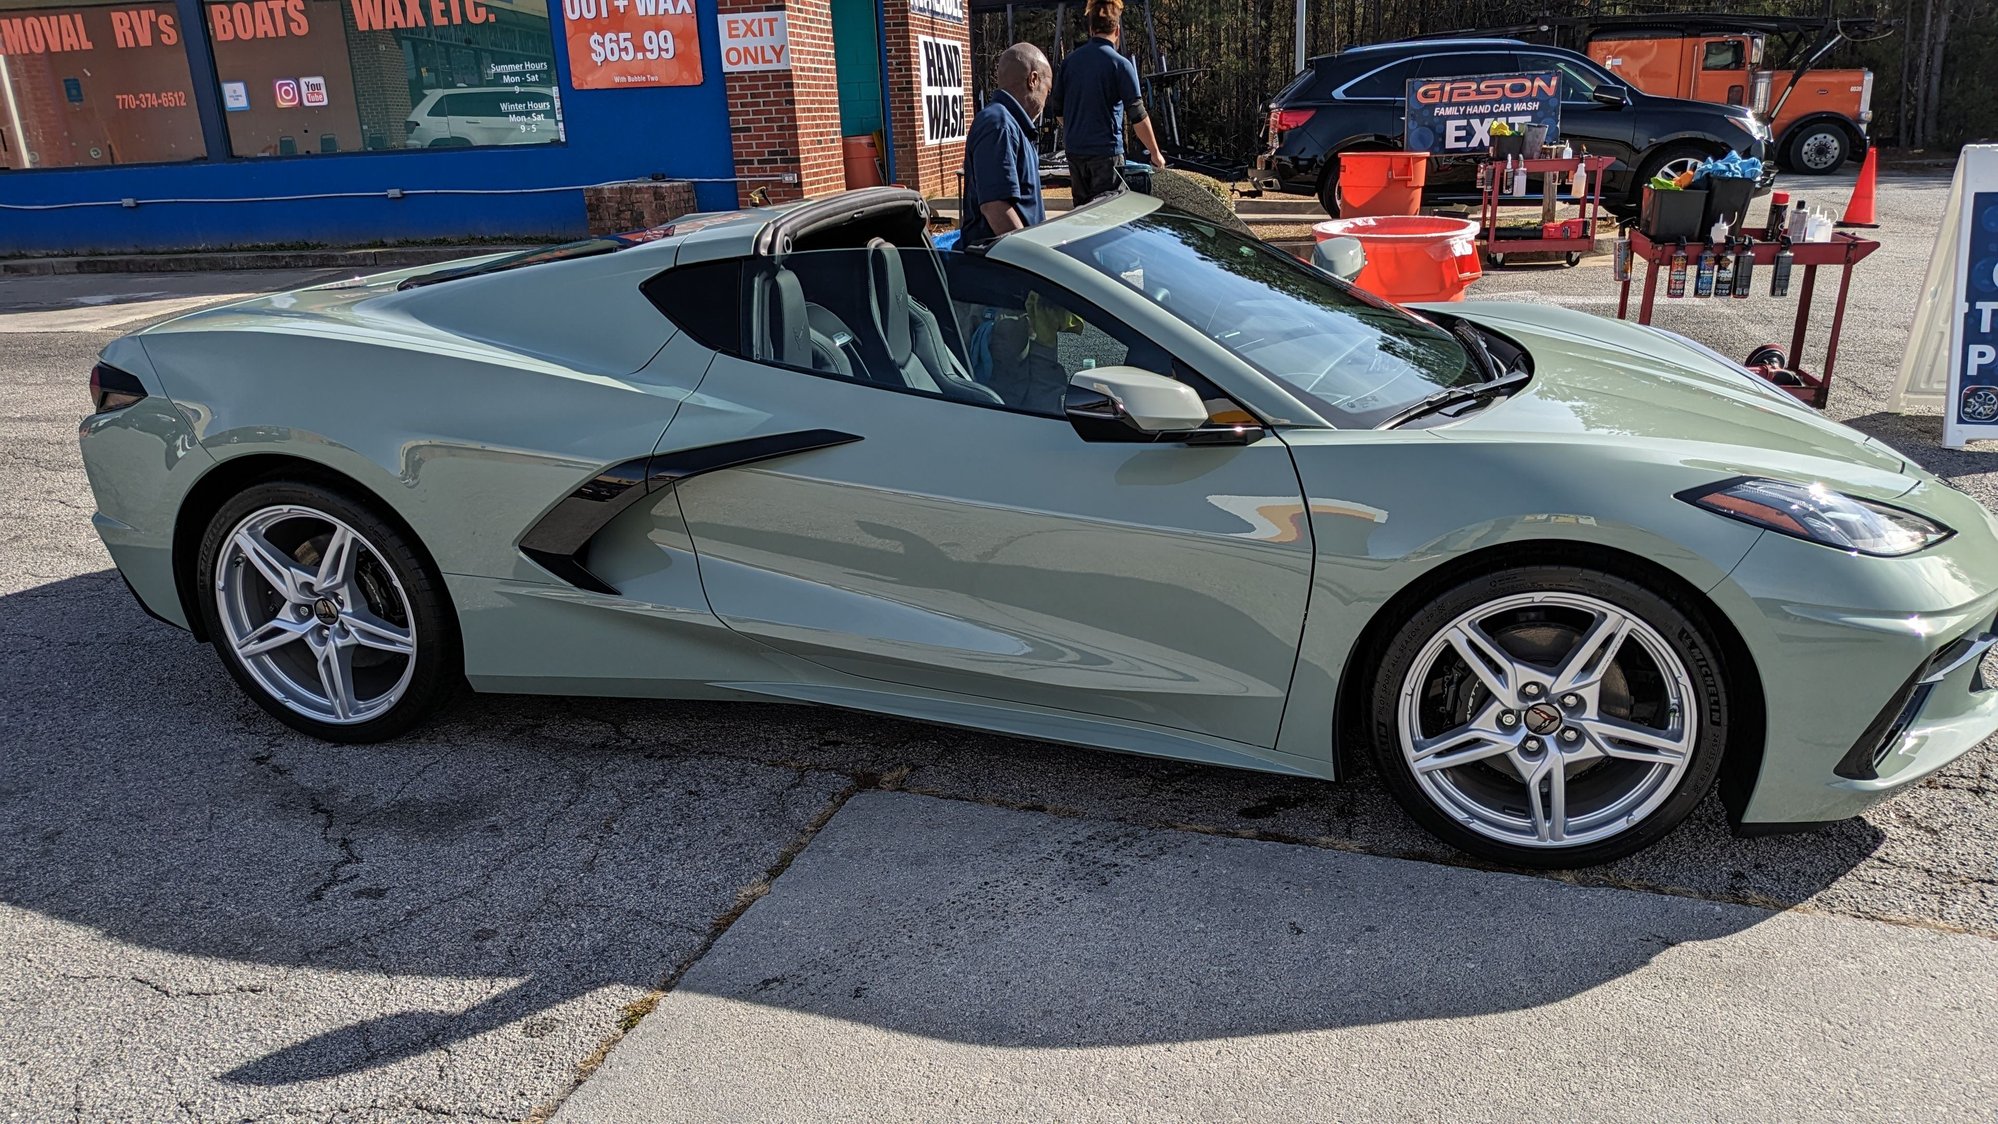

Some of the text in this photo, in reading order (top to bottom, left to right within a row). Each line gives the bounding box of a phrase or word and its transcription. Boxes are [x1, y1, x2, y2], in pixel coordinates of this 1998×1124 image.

[0, 0, 496, 55] MOVAL RV's BOATS WAX ETC.
[726, 17, 779, 39] EXIT
[589, 30, 675, 66] $65.99
[725, 44, 785, 66] ONLY
[491, 61, 548, 73] Summer Hours
[923, 40, 962, 88] HAND
[304, 80, 322, 92] You
[502, 74, 520, 83] Mon
[526, 73, 539, 82] Sat
[614, 74, 659, 83] With Bubble Two
[307, 92, 324, 103] Tube
[1416, 76, 1557, 104] GIBSON
[116, 92, 187, 109] 770-374-6512
[500, 101, 550, 111] Winter Hours
[1434, 101, 1540, 116] FAMILY HAND CAR WASH
[509, 114, 526, 122] Mon
[532, 113, 545, 121] Sat
[926, 95, 965, 140] WASH
[520, 124, 526, 133] 9
[531, 124, 537, 133] 5
[1445, 116, 1532, 149] EXT
[1690, 646, 1721, 723] MICHELIN
